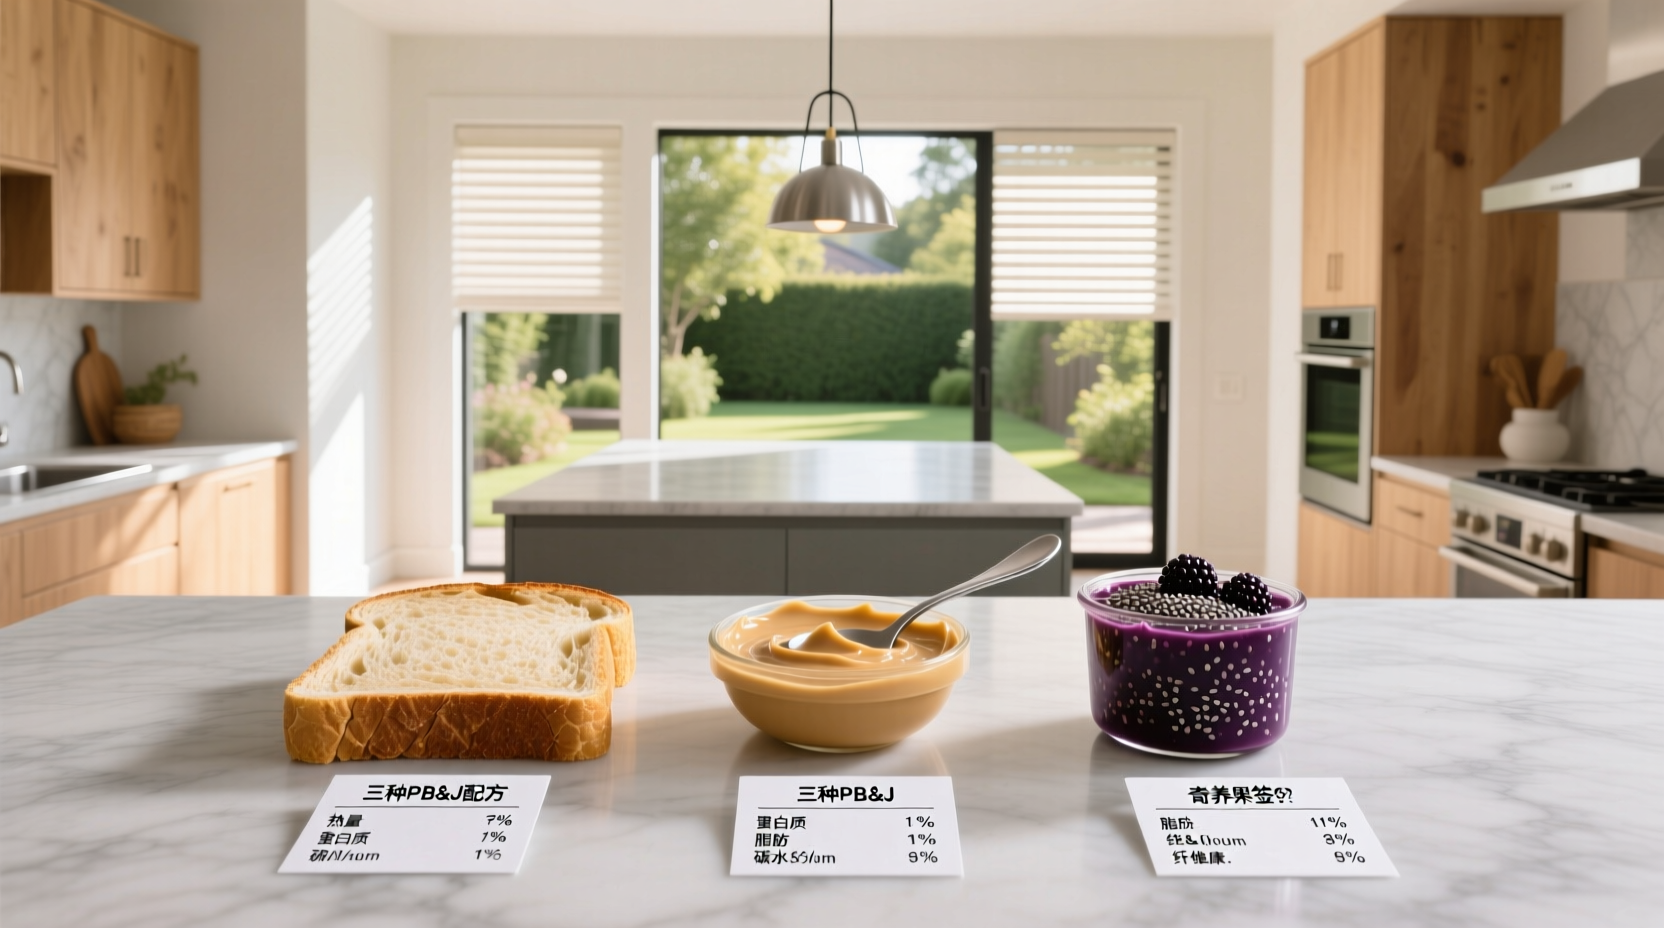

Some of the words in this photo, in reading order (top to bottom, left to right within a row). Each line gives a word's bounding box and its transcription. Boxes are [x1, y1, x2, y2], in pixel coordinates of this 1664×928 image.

[363, 784, 508, 802] 三种PB&J配方
[797, 785, 894, 803] 三种PB&J
